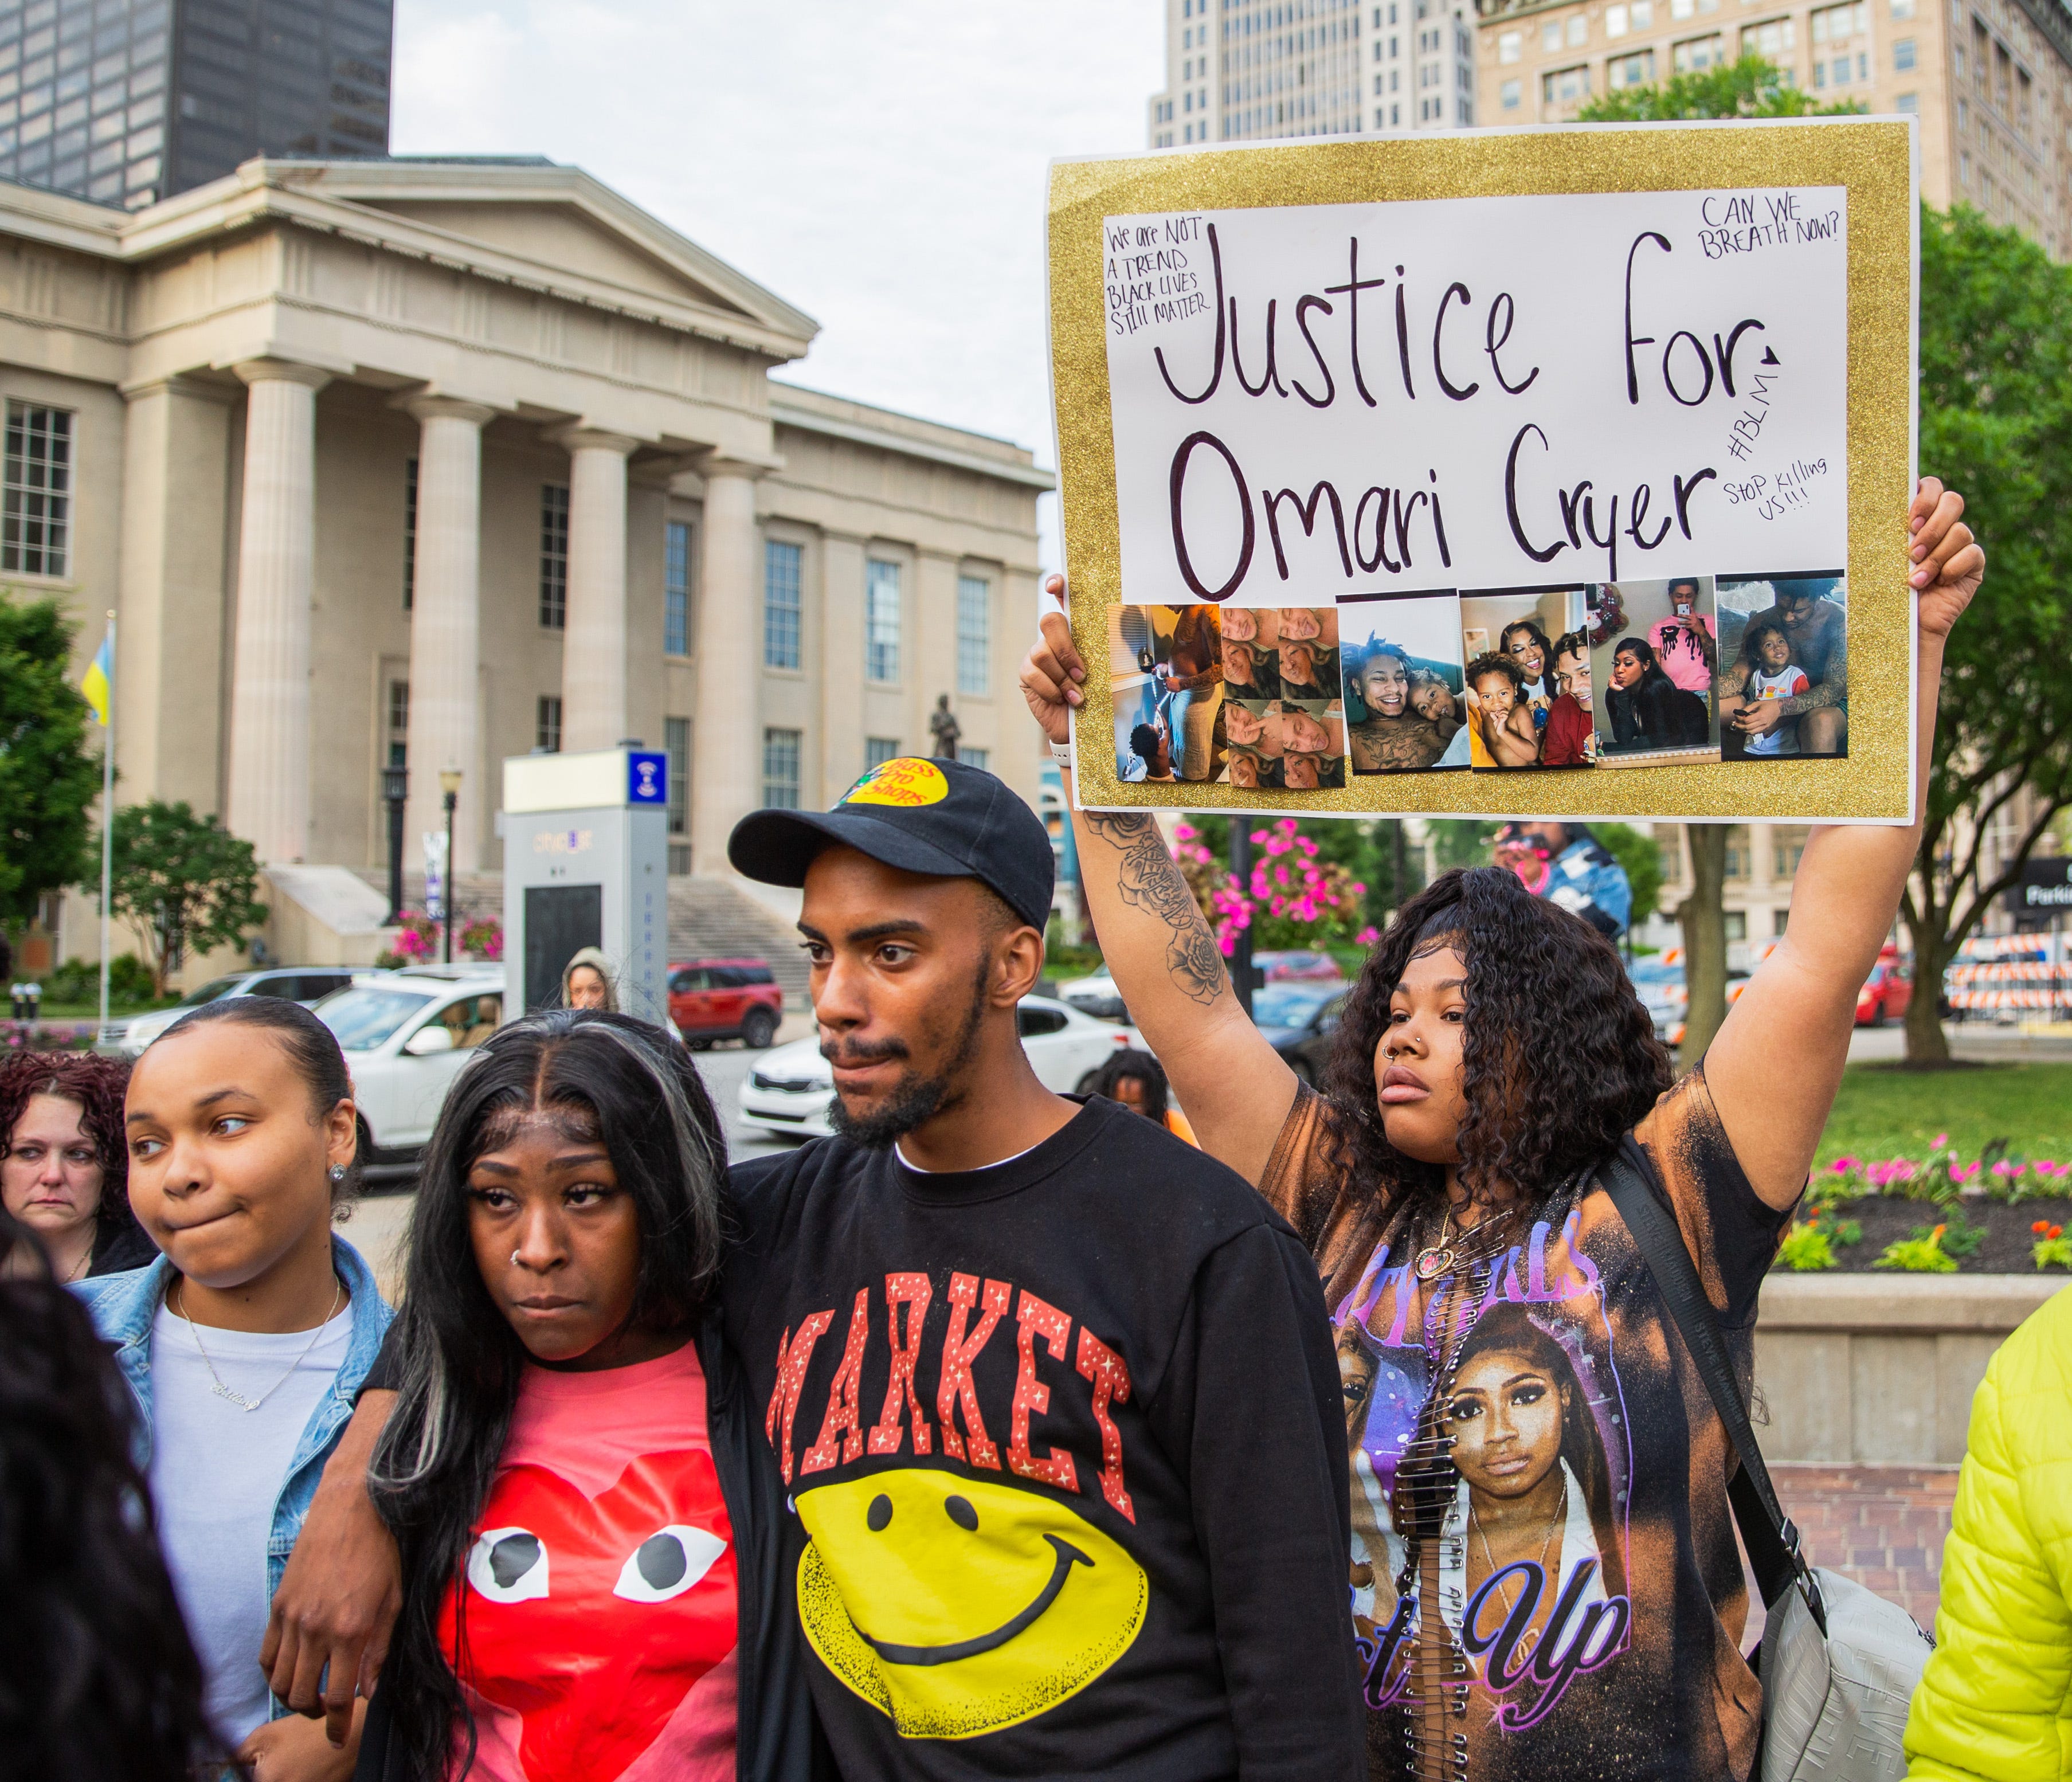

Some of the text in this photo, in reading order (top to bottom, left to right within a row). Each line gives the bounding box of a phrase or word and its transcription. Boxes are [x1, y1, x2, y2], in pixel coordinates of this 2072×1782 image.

[1702, 191, 1800, 227] CAN WE
[1166, 216, 1202, 244] NOT
[1698, 210, 1839, 259] BREATH NOW?
[1107, 249, 1188, 280] A TREND
[1107, 272, 1197, 310] BLACK LIVES
[1154, 292, 1211, 323] MATTER
[1153, 222, 1540, 409] Justice
[1727, 374, 1779, 461] #BLM
[1170, 423, 1717, 602] Omari Cryer
[879, 770, 915, 785] Pro
[889, 757, 939, 778] Bass
[864, 782, 927, 805] Shops
[765, 1271, 1136, 1525] MARKET
[1462, 1556, 1631, 1731] Up
